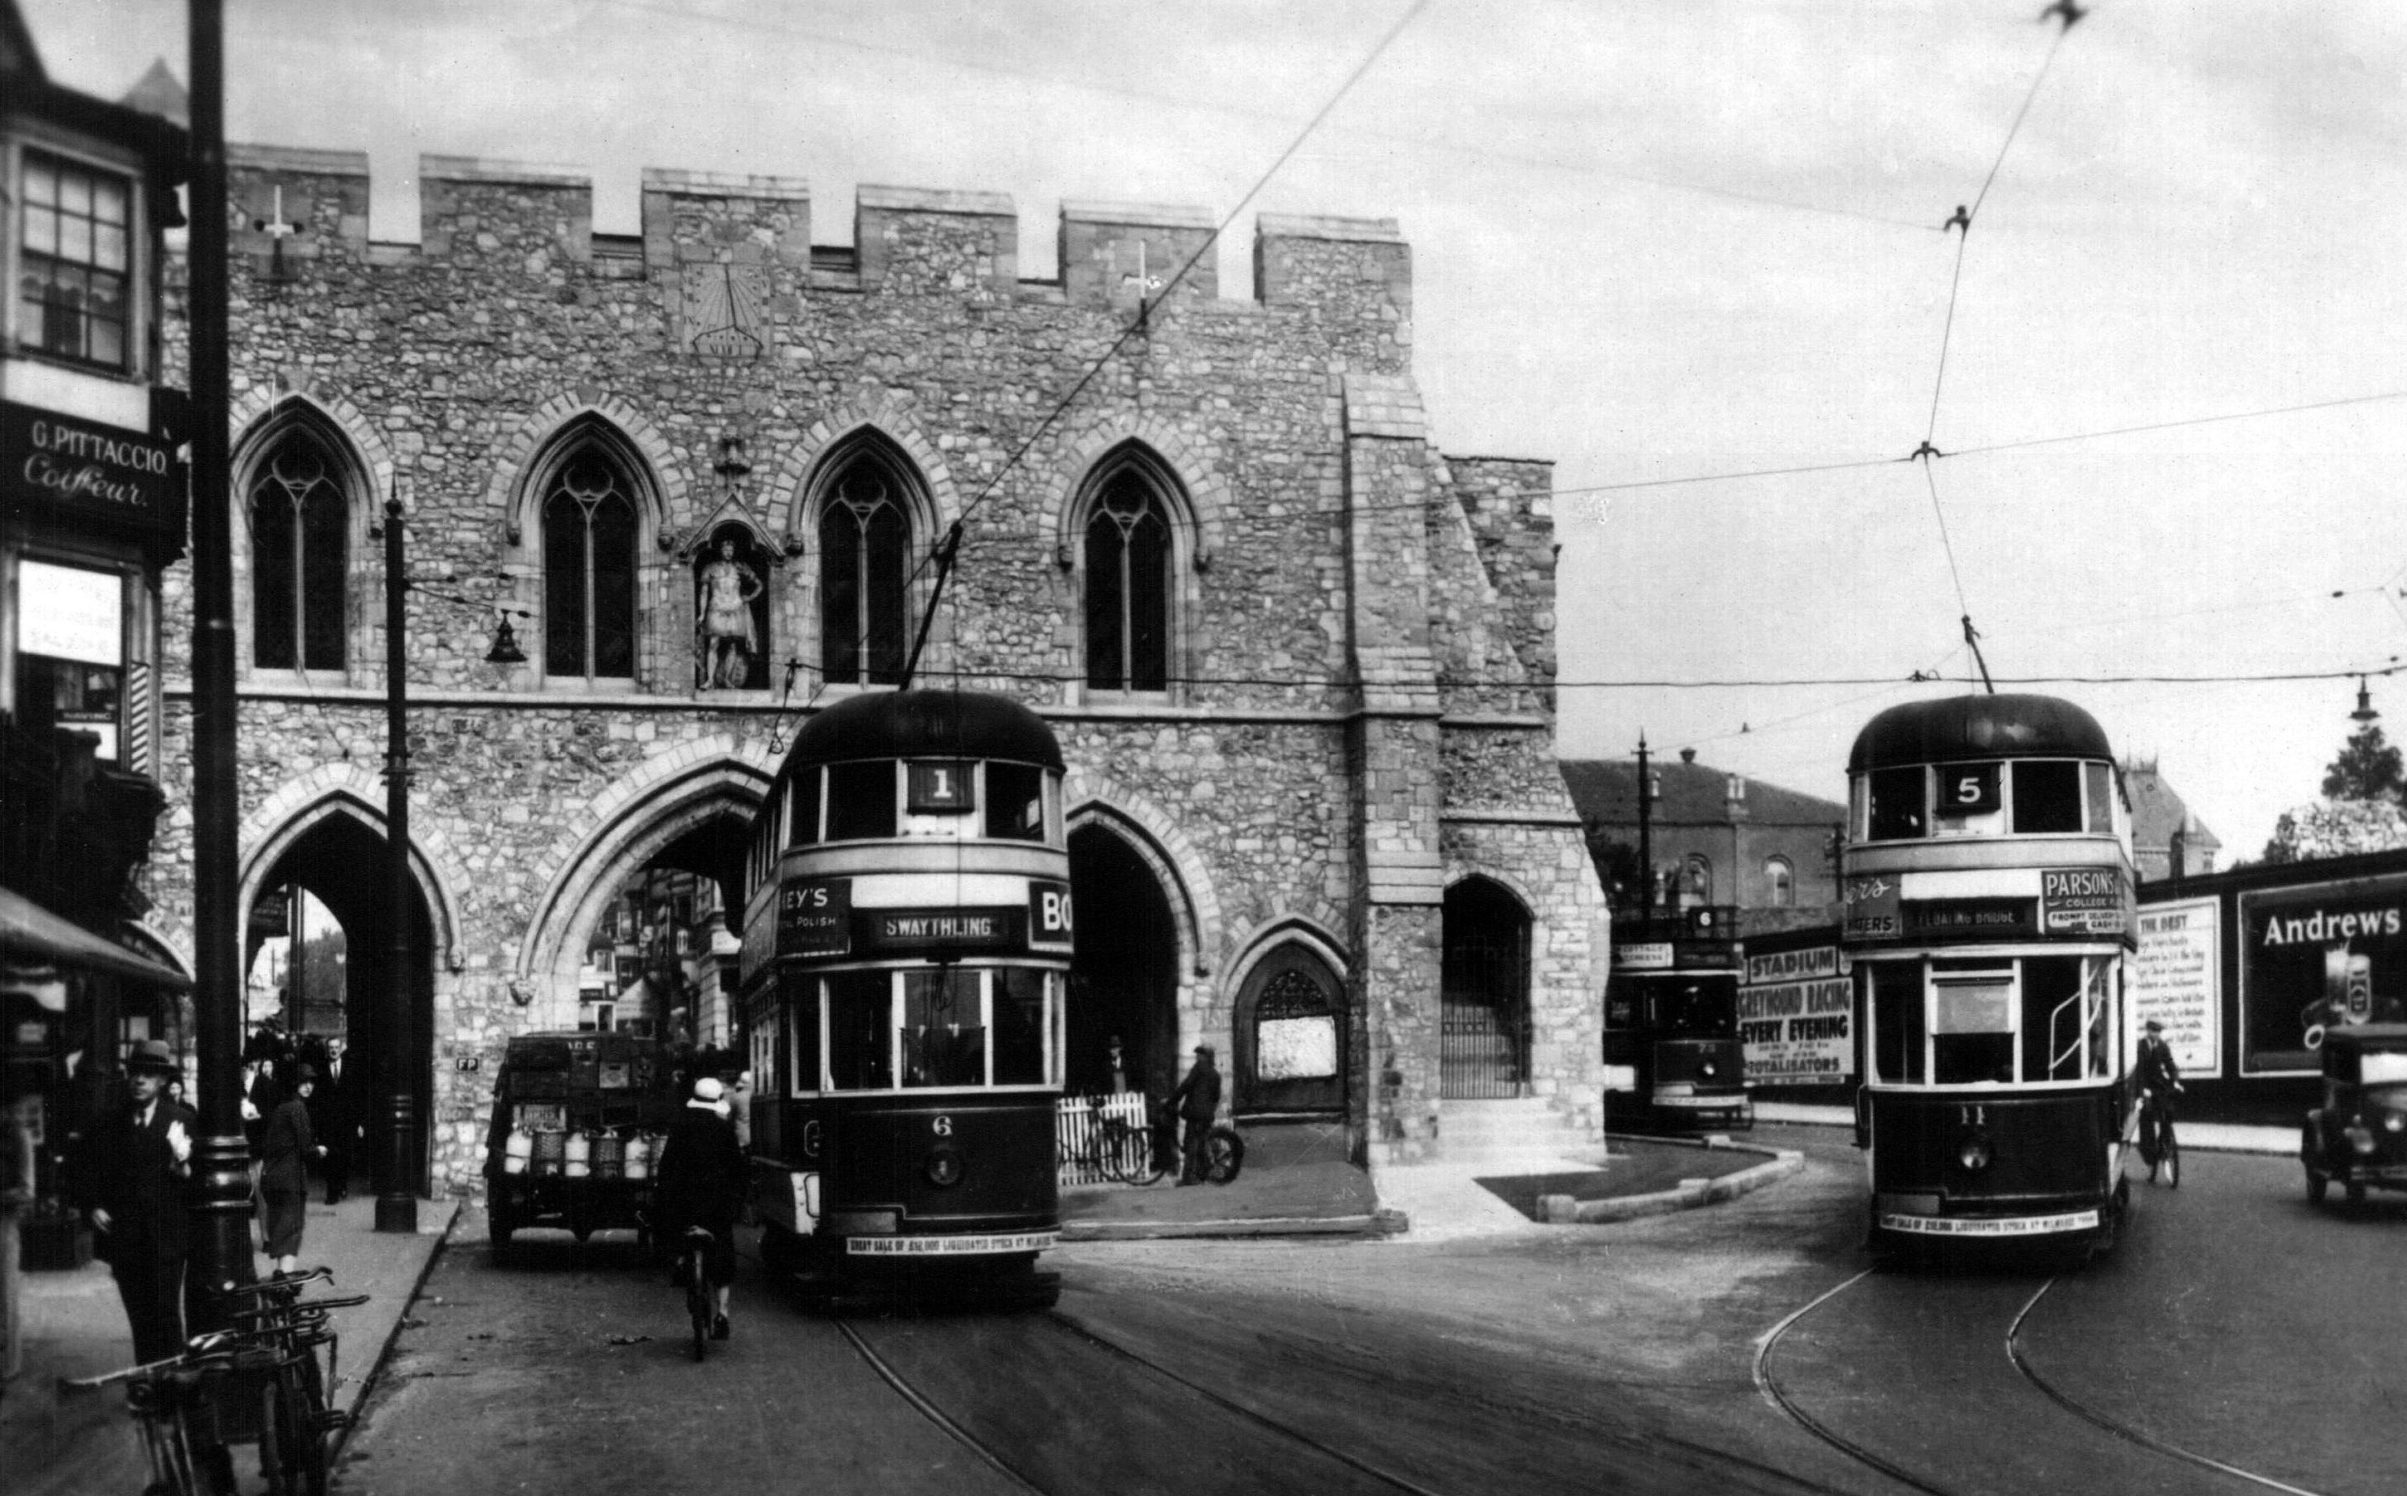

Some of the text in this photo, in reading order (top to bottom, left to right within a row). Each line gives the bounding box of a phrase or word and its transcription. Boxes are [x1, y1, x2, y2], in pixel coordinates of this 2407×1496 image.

[933, 769, 953, 798] 1
[1957, 777, 1982, 803] 5
[2045, 872, 2114, 897] PARSONS
[796, 915, 837, 927] POLISH
[885, 917, 992, 937] SWAYTHLING
[2262, 908, 2401, 946] Andrews
[1751, 948, 1834, 977] STADIUM
[1741, 1014, 1848, 1045] EVERY EVENING
[932, 1115, 953, 1136] 6
[1961, 1105, 1985, 1125] 11
